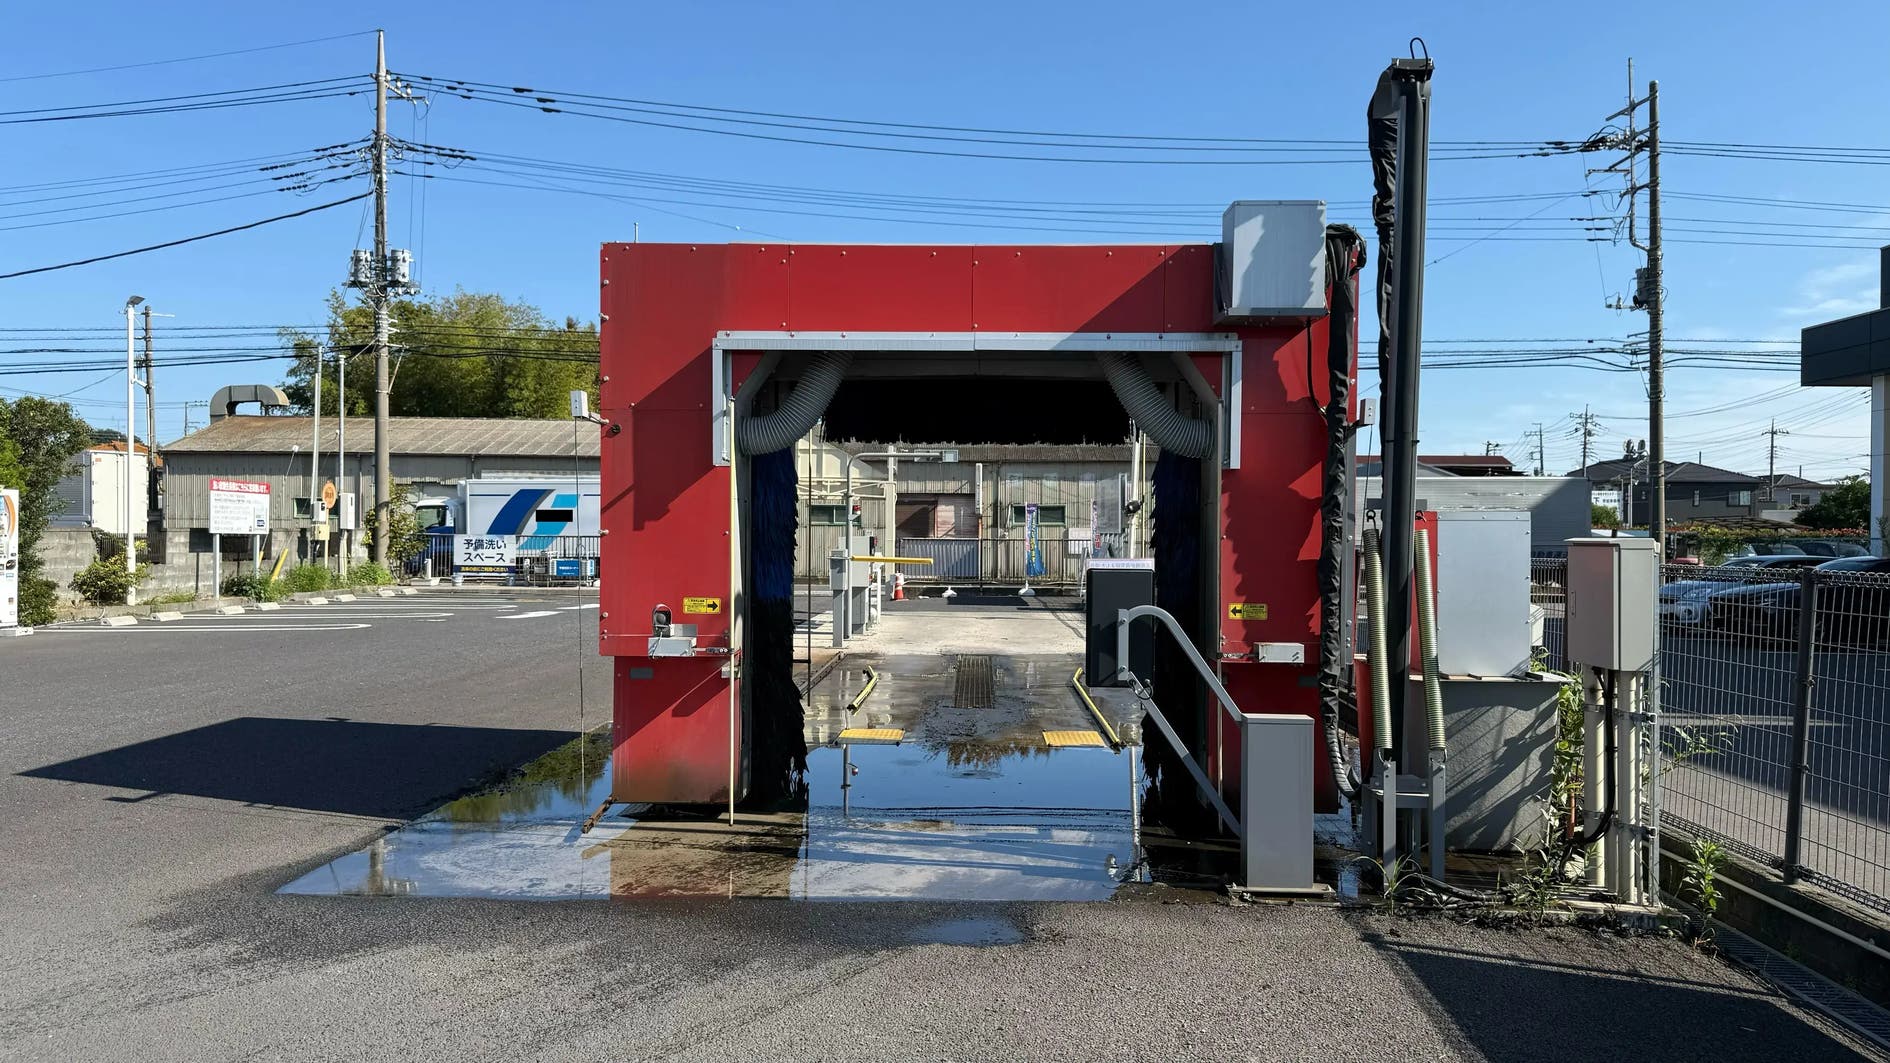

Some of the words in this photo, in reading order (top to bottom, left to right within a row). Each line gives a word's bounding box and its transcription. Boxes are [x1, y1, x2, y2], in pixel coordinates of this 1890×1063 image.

[463, 538, 507, 550] 予備洗い
[463, 552, 506, 563] スペース
